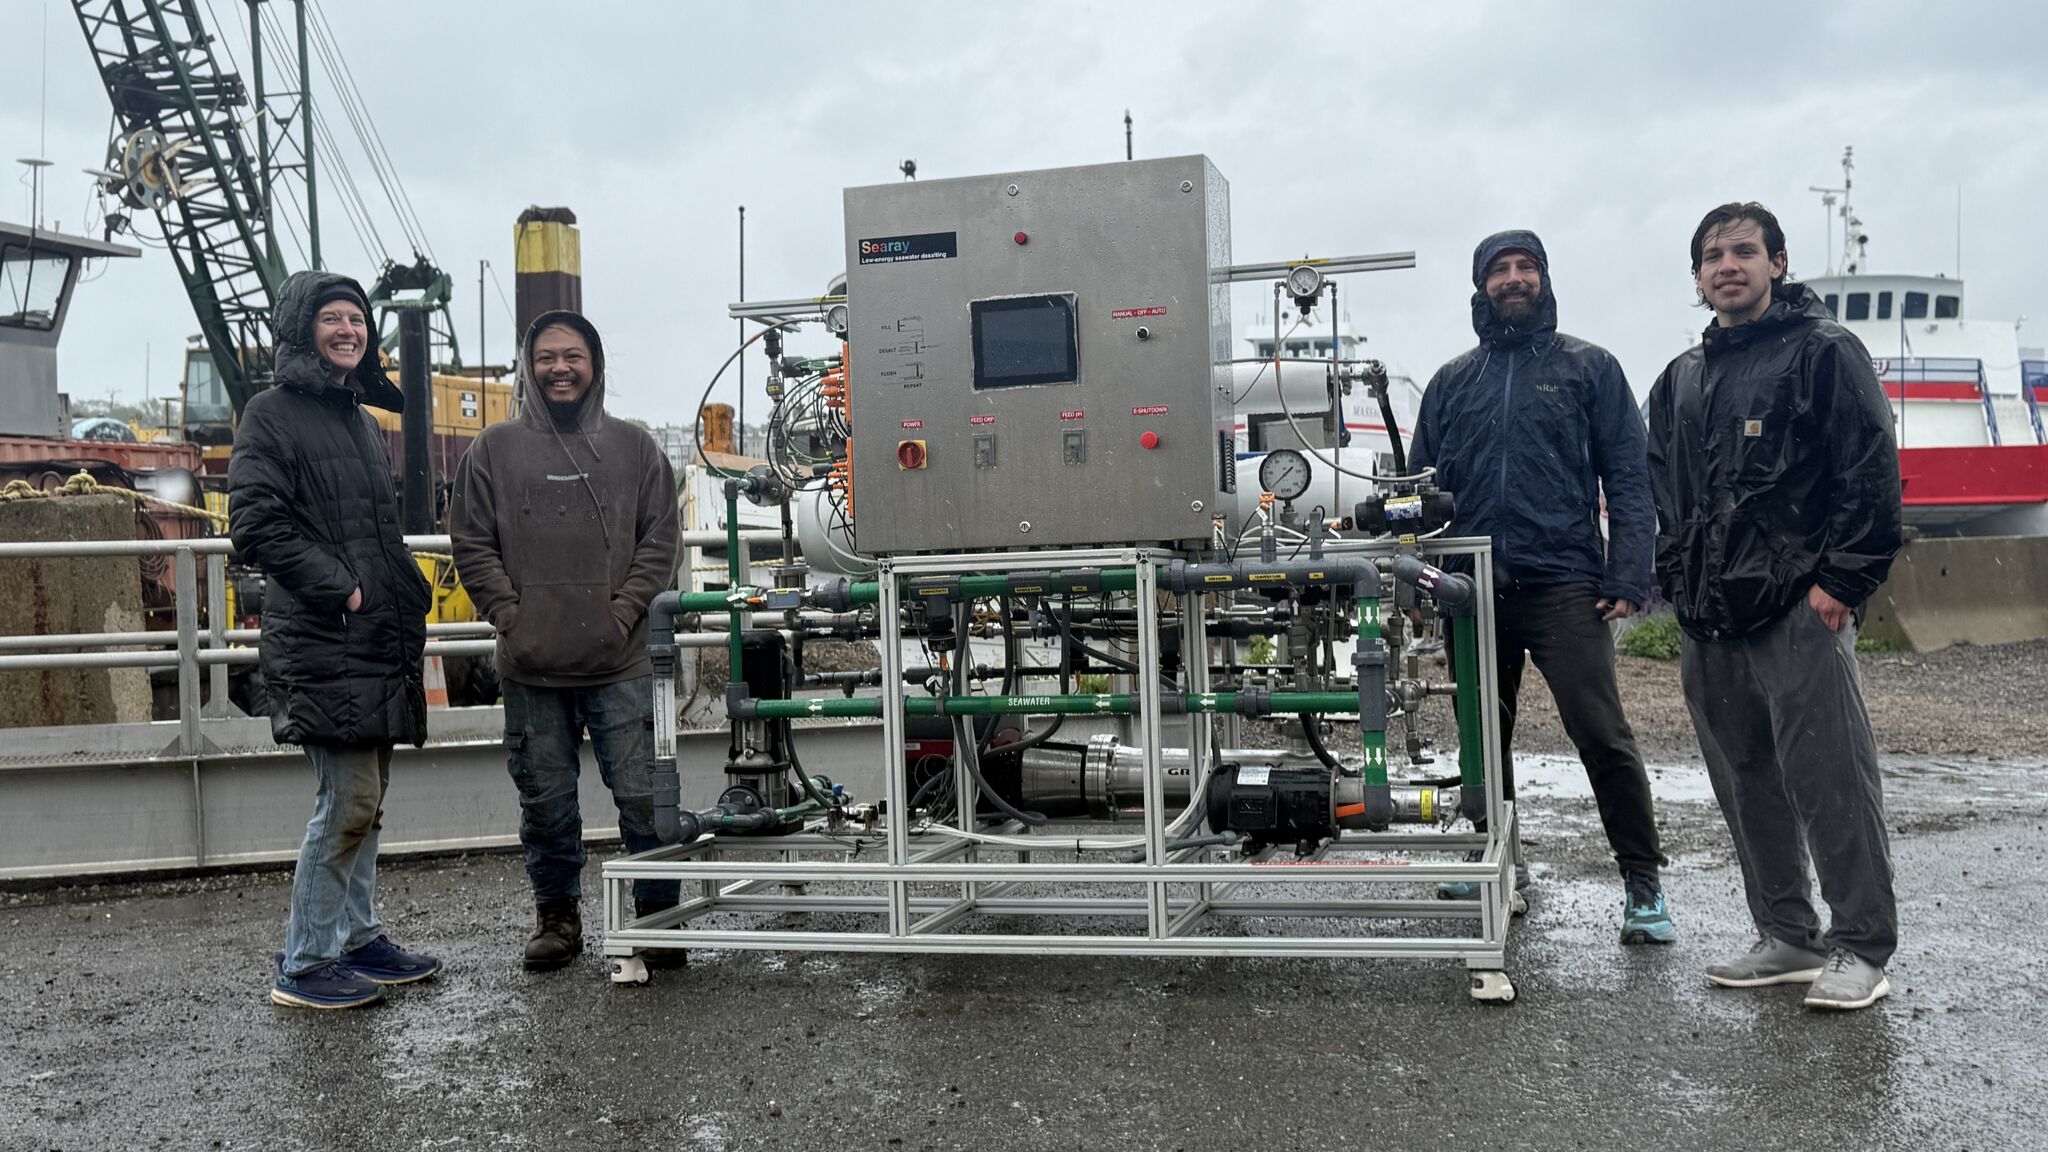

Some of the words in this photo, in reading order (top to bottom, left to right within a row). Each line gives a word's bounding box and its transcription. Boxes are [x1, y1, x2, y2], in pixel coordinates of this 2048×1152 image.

[862, 241, 910, 254] Searay
[861, 256, 894, 264] Low-energy
[895, 253, 920, 261] seawater
[1008, 697, 1050, 706] SEAWATER
